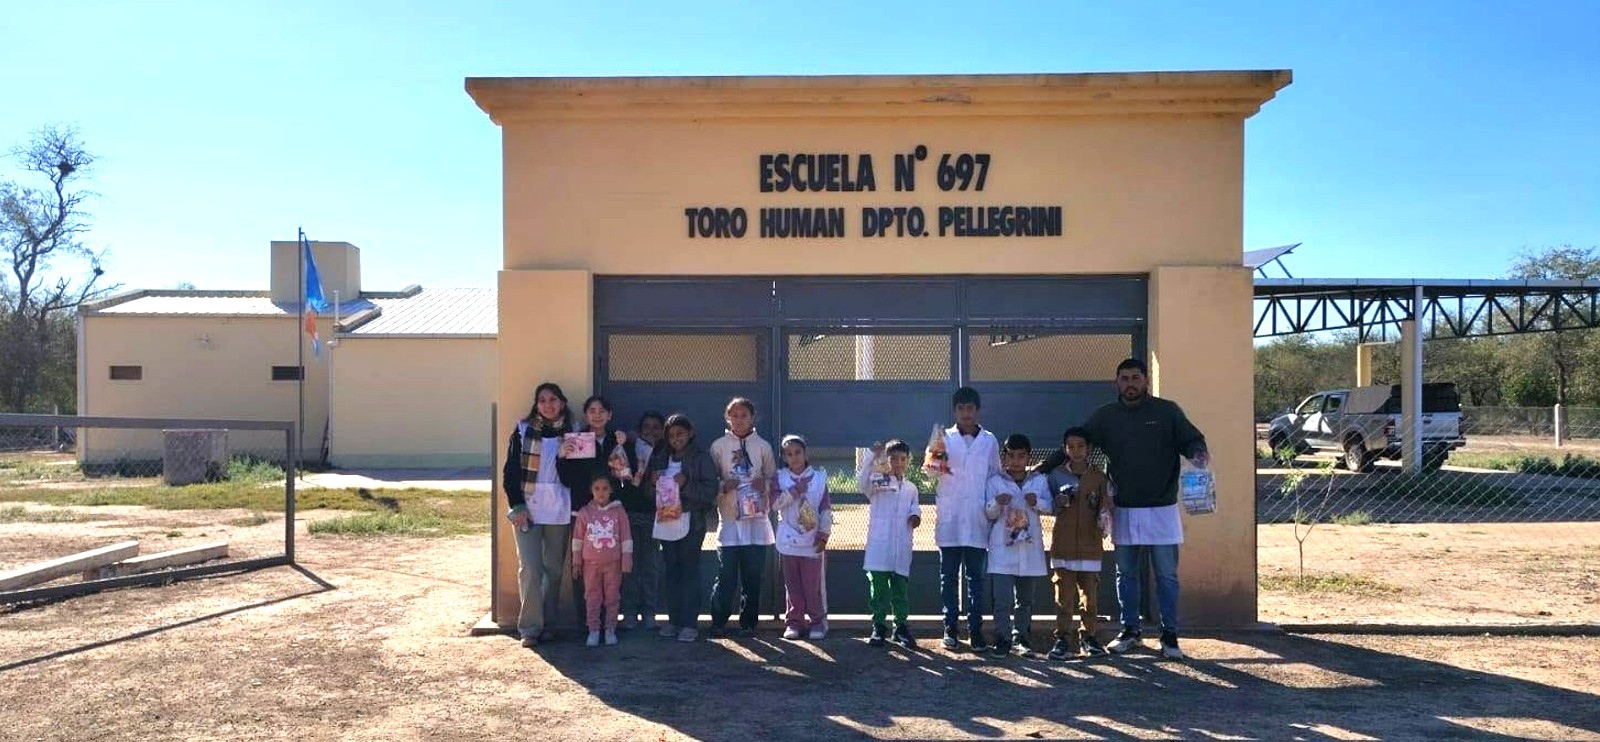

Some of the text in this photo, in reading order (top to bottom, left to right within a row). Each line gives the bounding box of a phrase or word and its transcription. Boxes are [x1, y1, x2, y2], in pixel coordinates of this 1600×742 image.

[759, 153, 876, 193] ESCUELA
[936, 152, 991, 192] 697
[684, 205, 1063, 239] TORO HUMAN DPTO. PELLEGRINI
